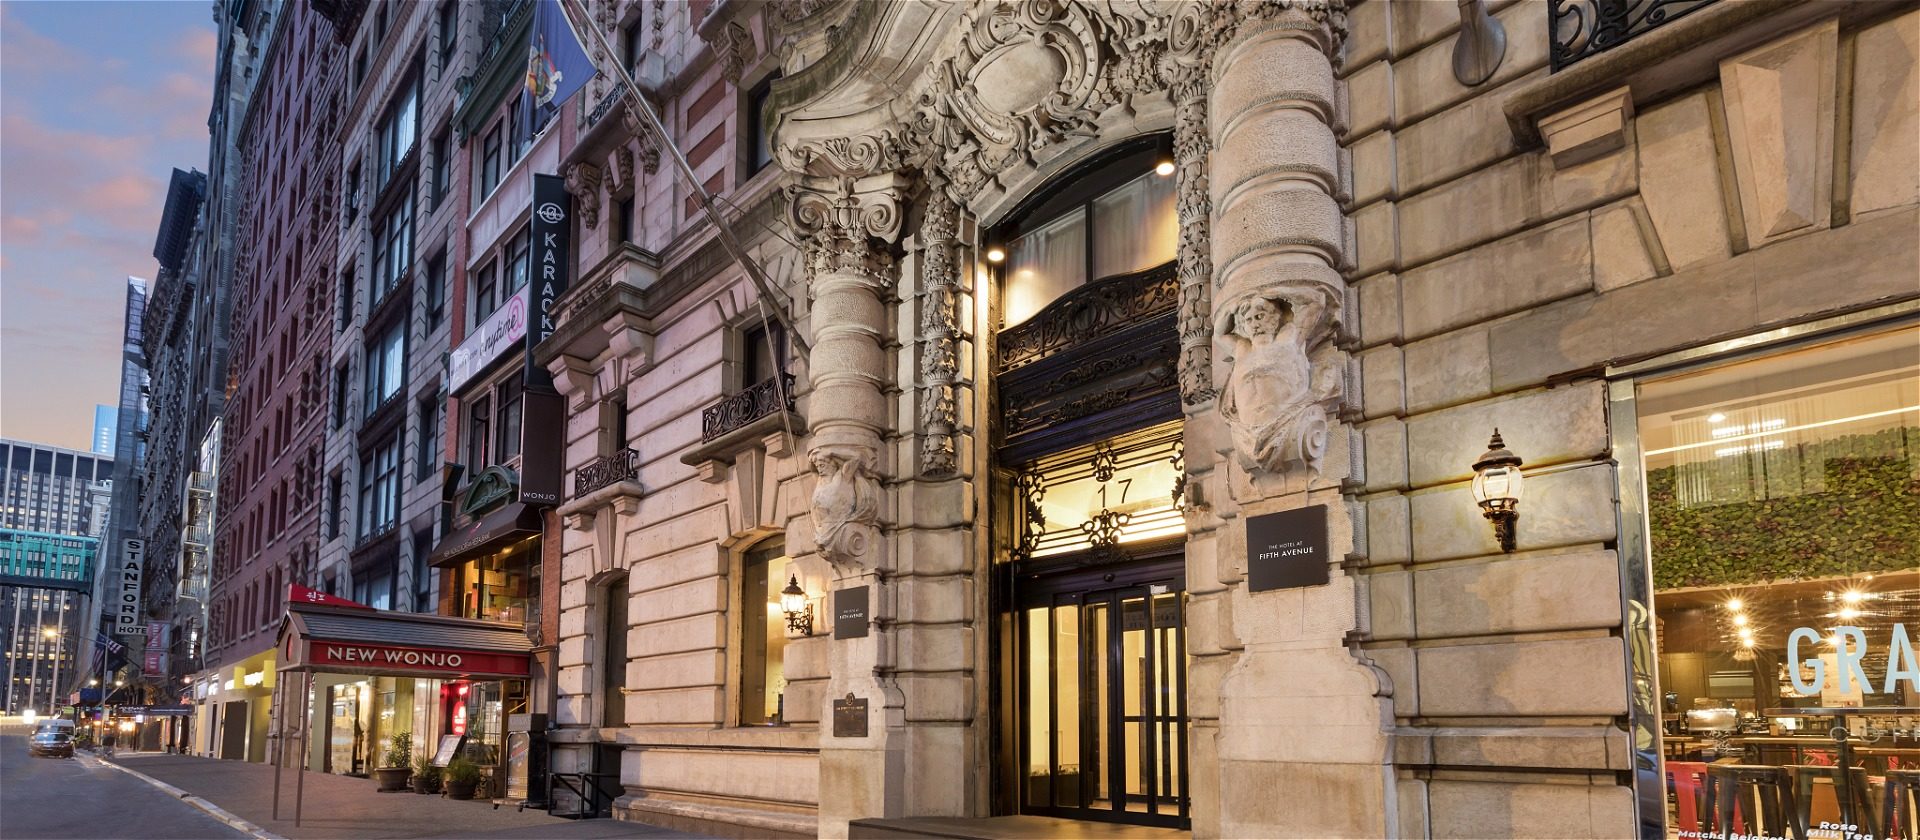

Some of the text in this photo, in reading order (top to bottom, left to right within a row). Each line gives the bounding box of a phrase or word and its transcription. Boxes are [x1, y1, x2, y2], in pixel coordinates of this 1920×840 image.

[523, 492, 556, 501] WONJO
[1097, 478, 1133, 508] 17
[1259, 546, 1314, 561] FIFTH AVENUE
[120, 541, 141, 624] STANFORD
[327, 646, 462, 667] NEW WONJO
[1787, 622, 1920, 695] GRA
[1819, 821, 1858, 832] Rose
[1678, 830, 1725, 840] Matcha
[1806, 829, 1874, 840] Milk Tea
